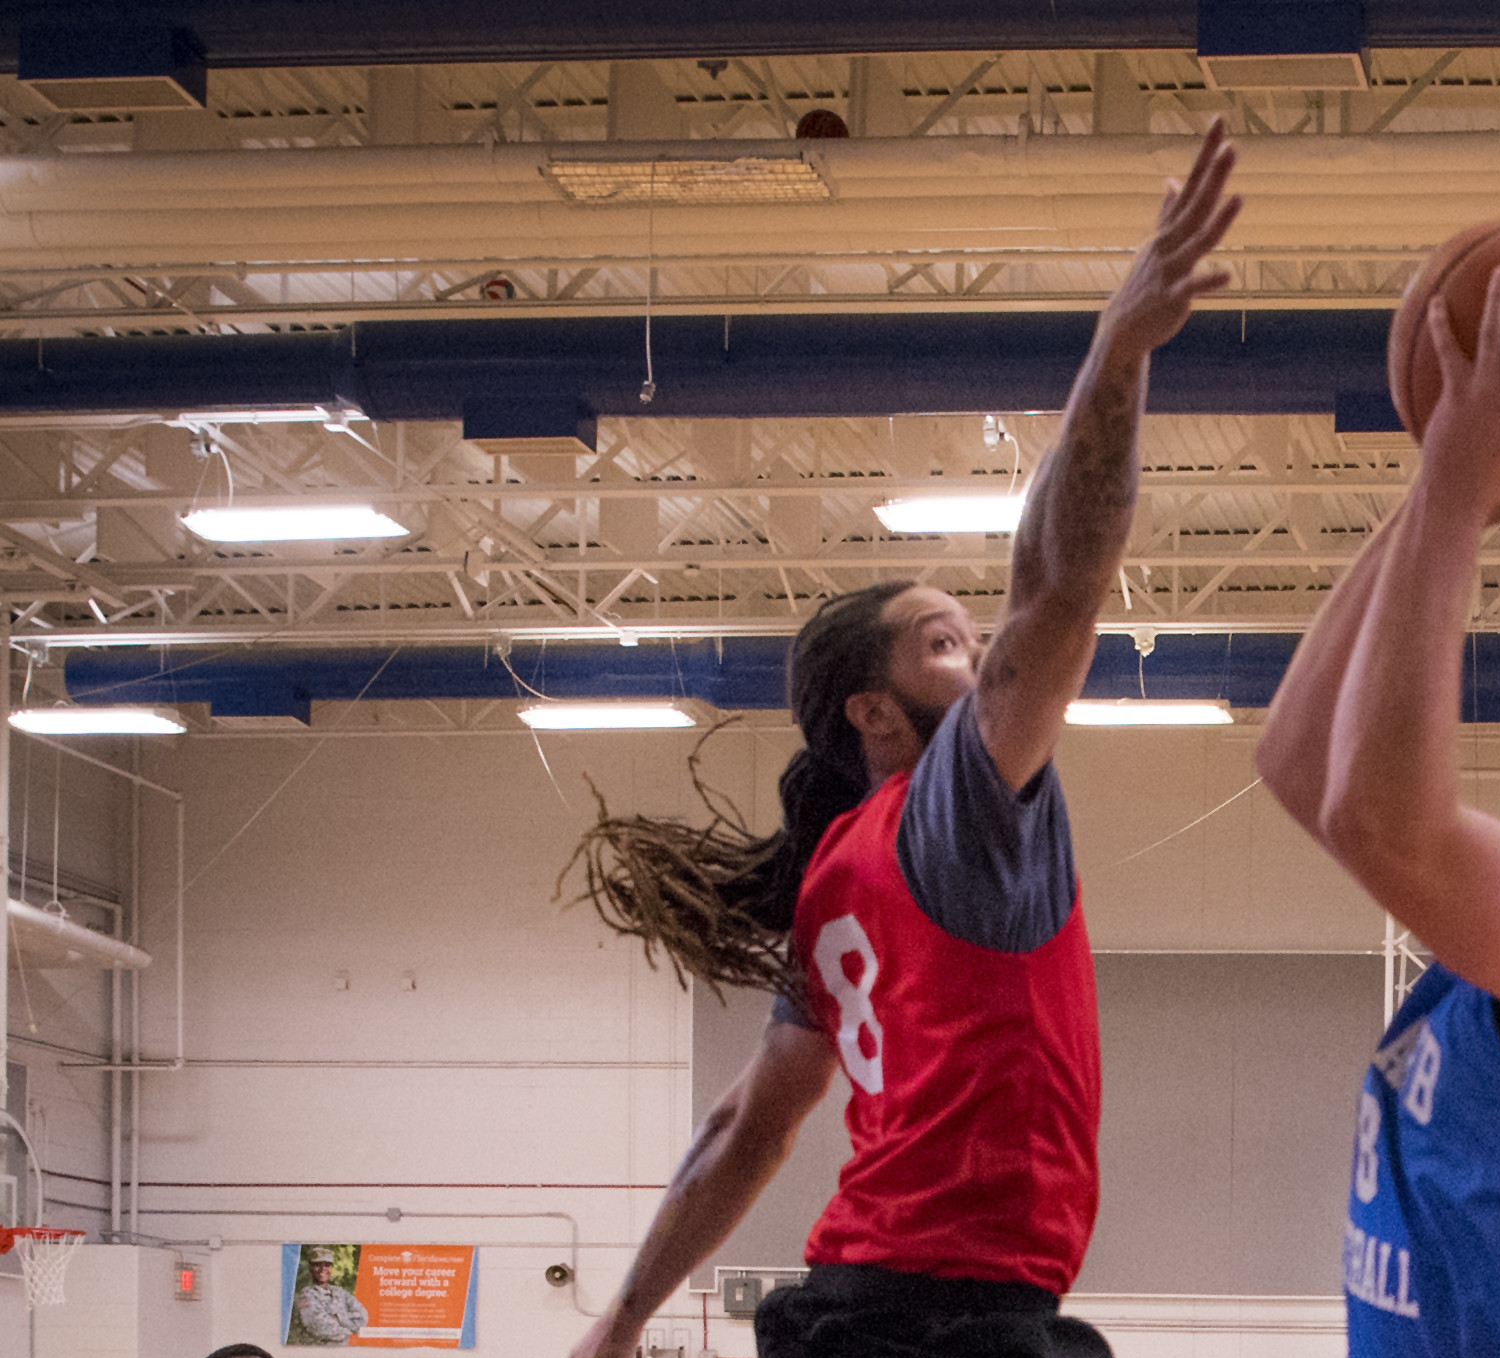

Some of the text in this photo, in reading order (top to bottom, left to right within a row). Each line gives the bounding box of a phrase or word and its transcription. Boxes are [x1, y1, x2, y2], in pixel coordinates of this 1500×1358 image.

[815, 914, 883, 1096] 8
[373, 1266, 456, 1278] Move your career
[380, 1276, 449, 1287] forward with a
[379, 1287, 449, 1299] college degree.
